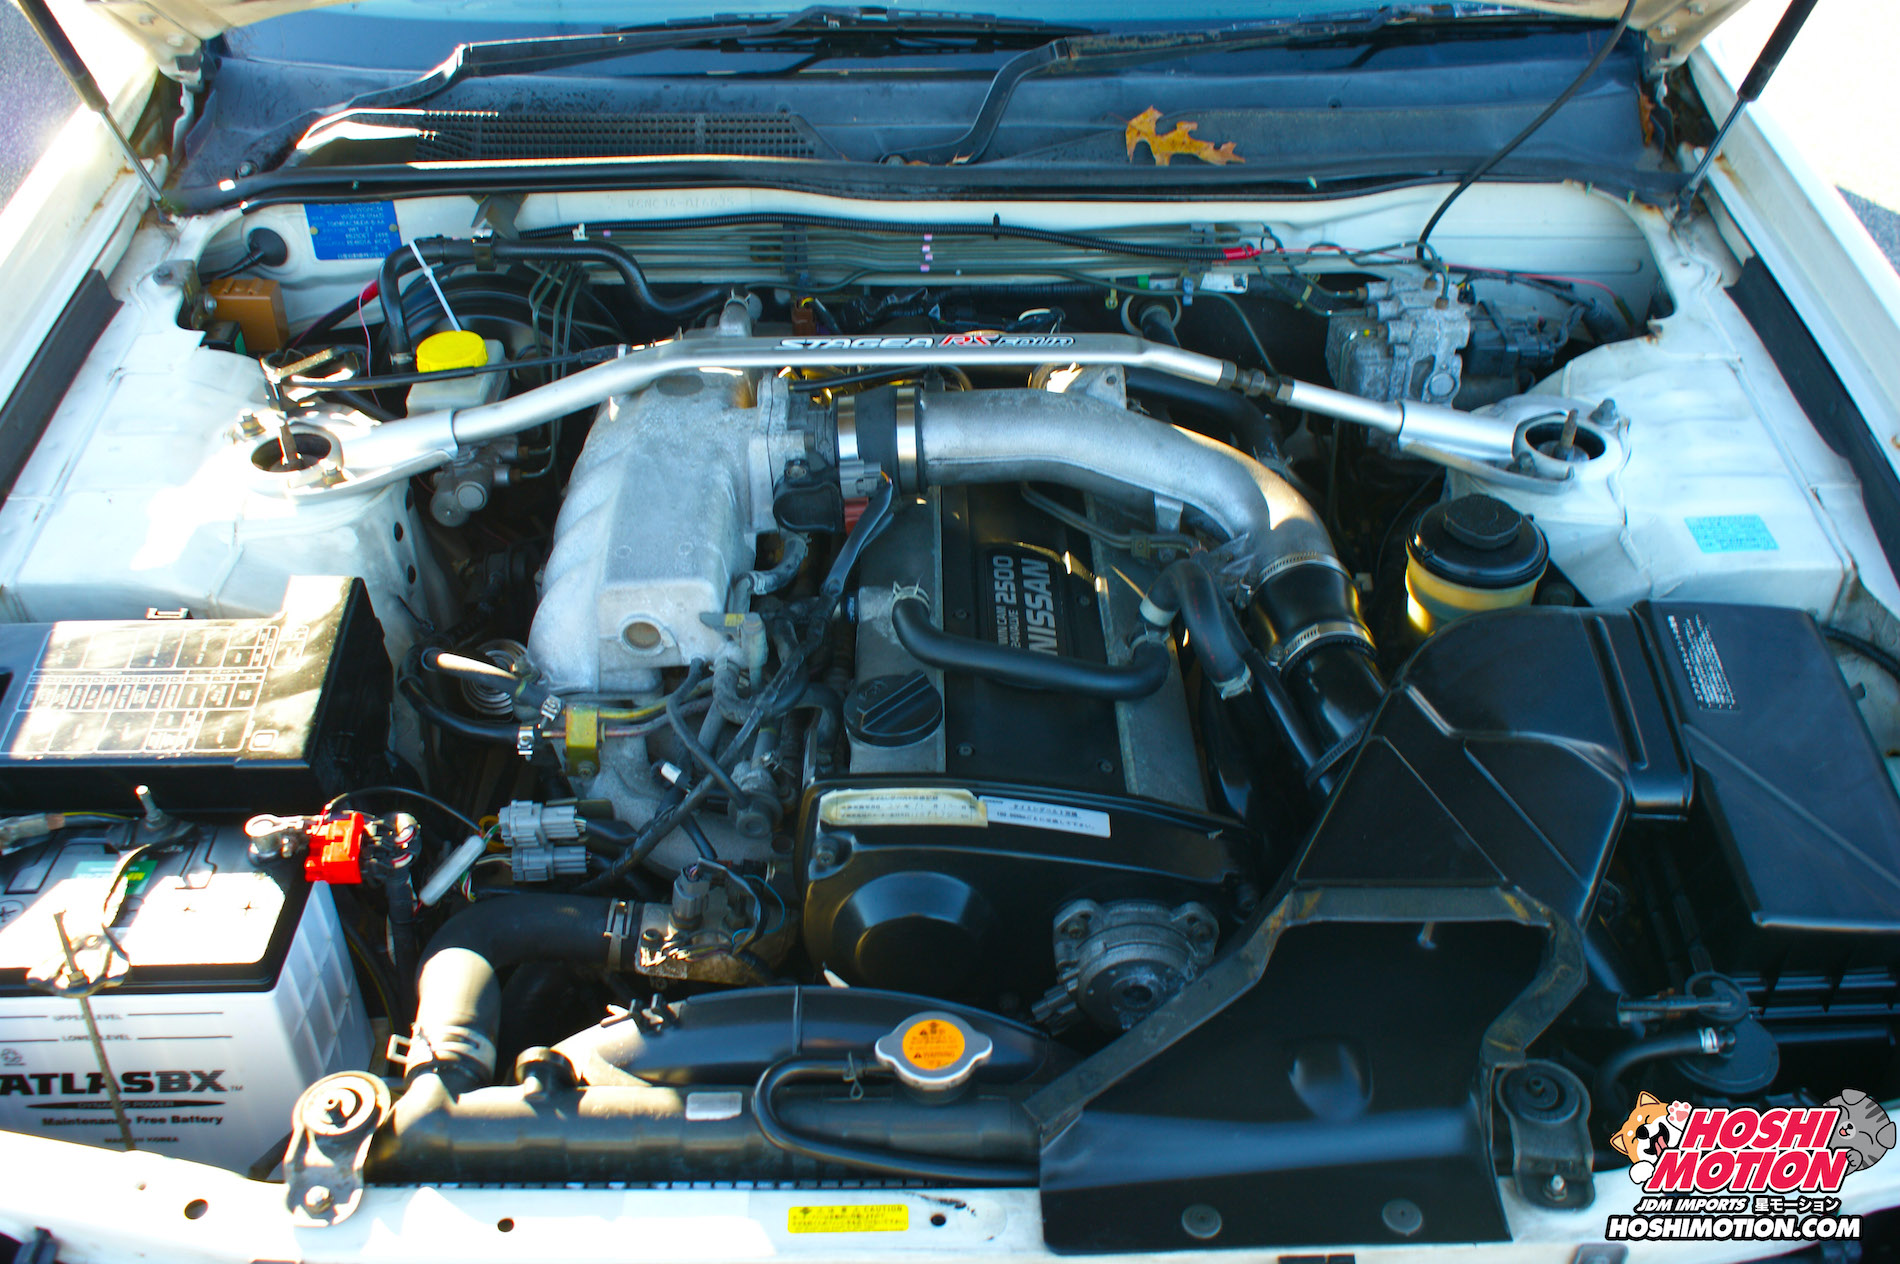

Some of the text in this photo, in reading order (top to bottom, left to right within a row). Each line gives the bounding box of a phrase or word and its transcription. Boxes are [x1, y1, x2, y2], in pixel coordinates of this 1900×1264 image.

[992, 555, 1017, 605] 2500
[1020, 557, 1058, 657] NISSAN
[43, 1115, 224, 1126] Maintenane Free Battery
[863, 1203, 903, 1213] CAUTION
